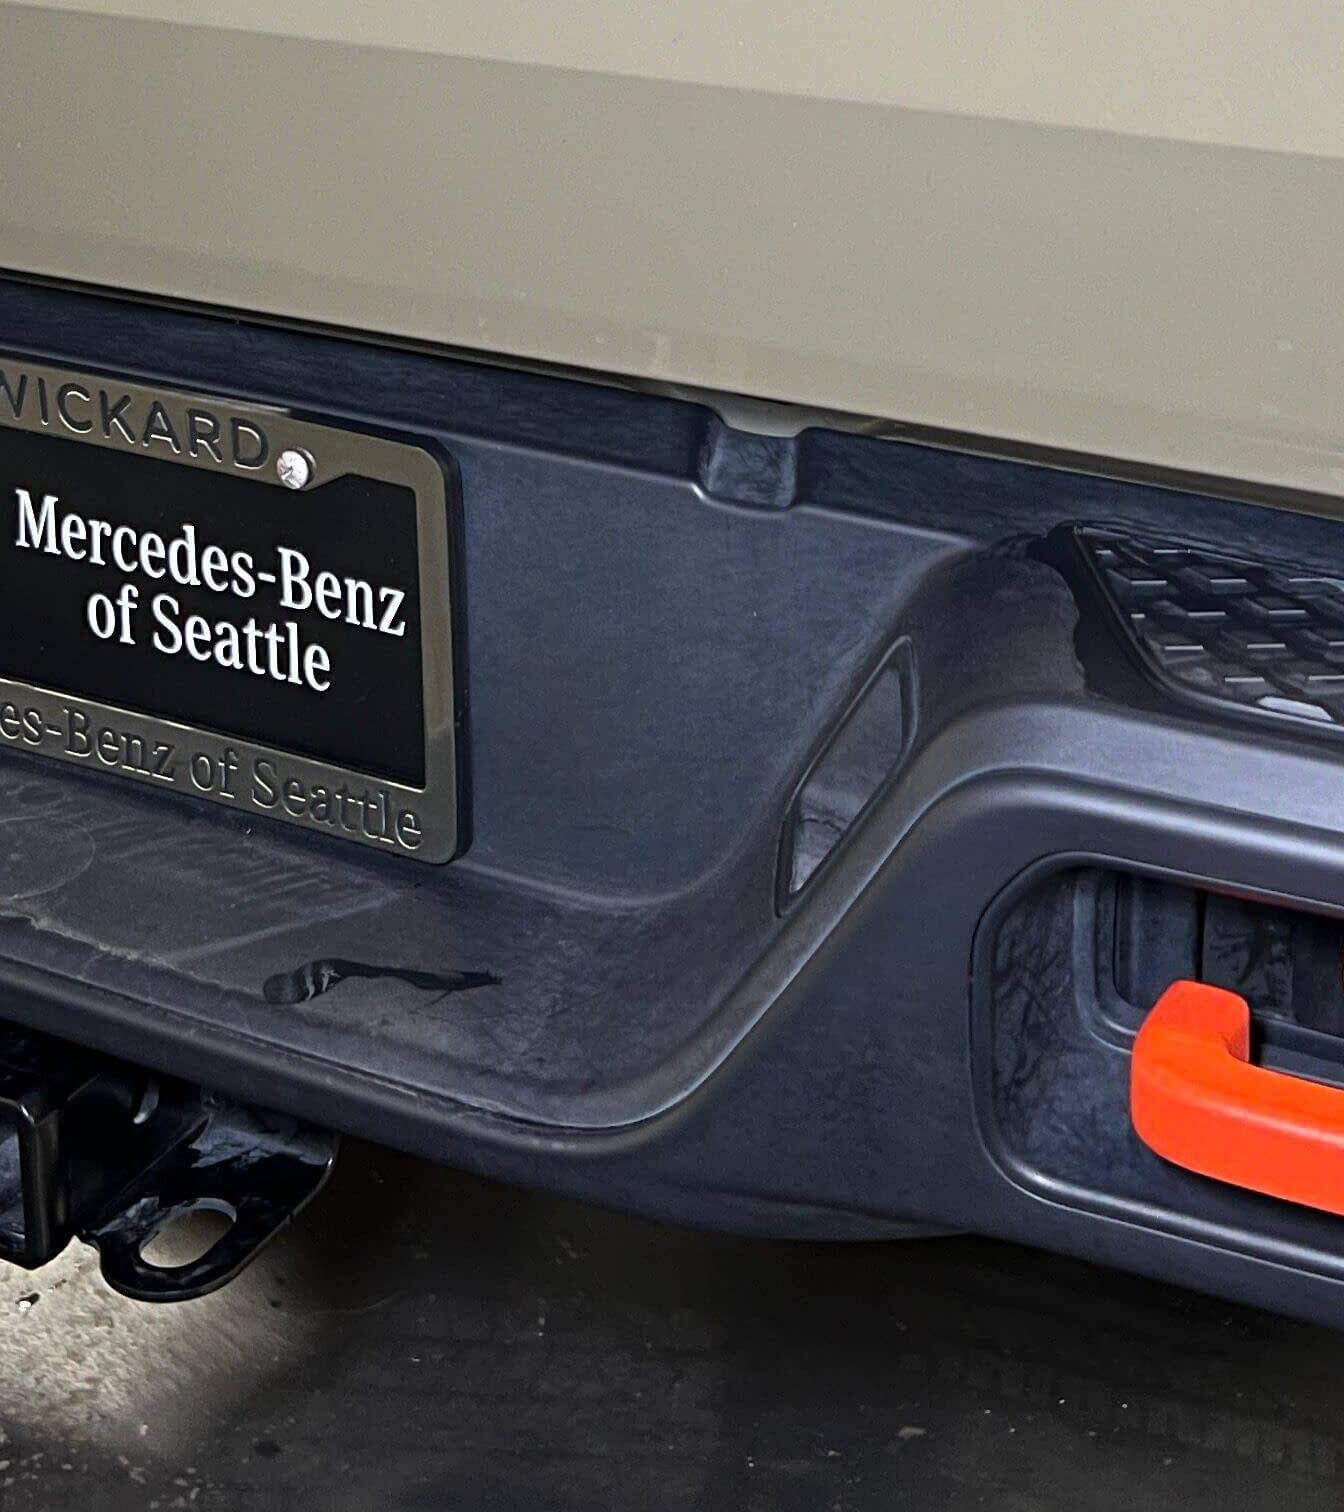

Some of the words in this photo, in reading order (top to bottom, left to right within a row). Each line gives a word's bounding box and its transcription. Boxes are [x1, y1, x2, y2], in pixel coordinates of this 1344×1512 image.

[14, 488, 408, 637] Mercedes-Benz
[87, 584, 140, 645] of
[153, 597, 331, 693] Seattle
[191, 748, 240, 797] of
[251, 759, 424, 851] Seattle
